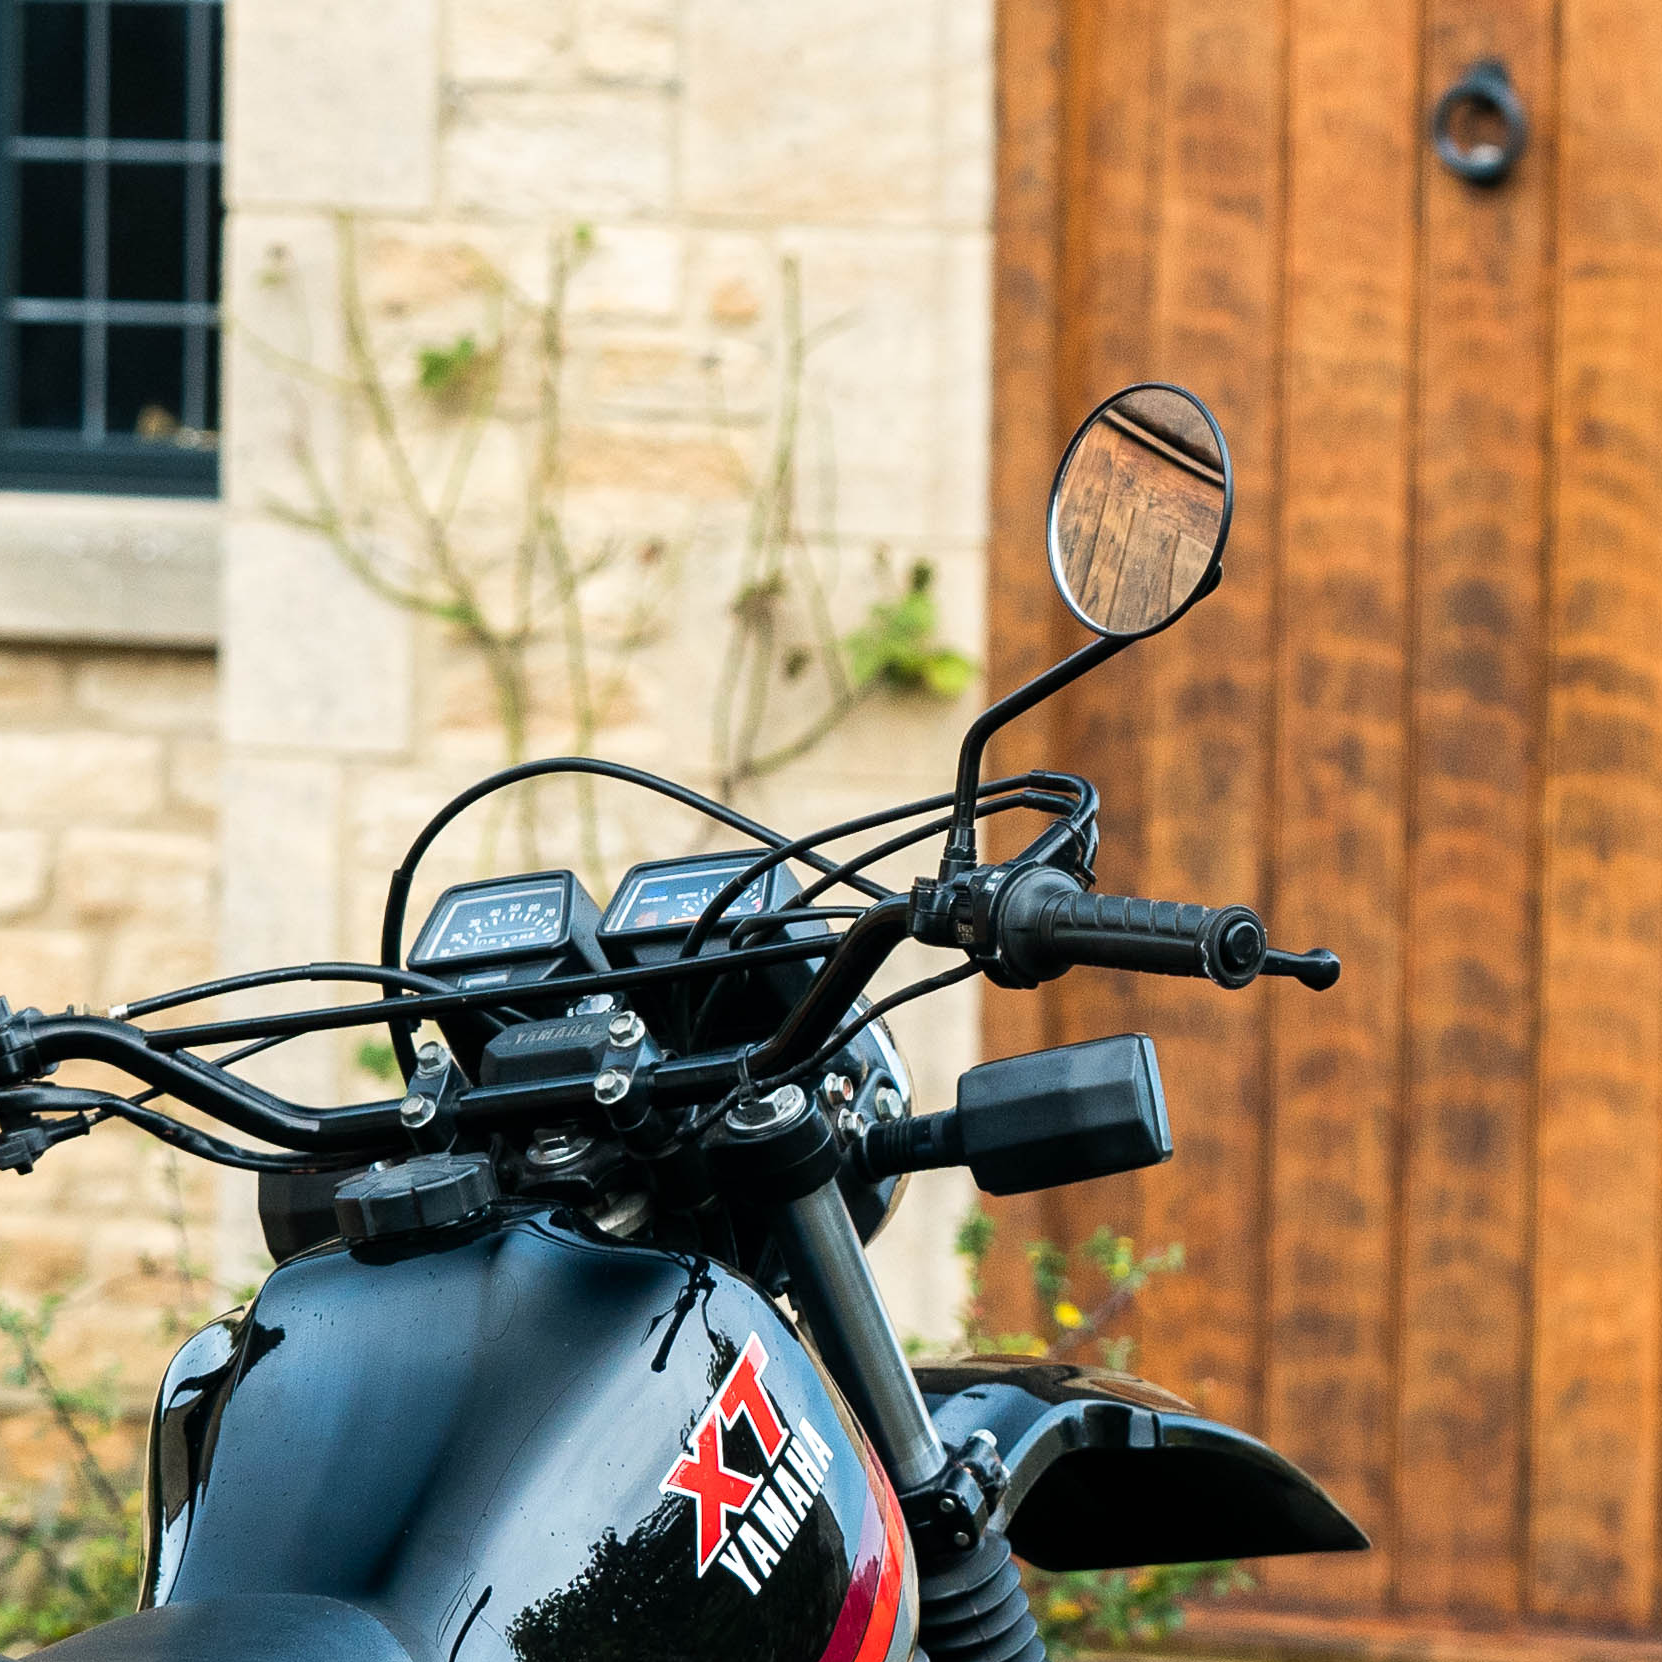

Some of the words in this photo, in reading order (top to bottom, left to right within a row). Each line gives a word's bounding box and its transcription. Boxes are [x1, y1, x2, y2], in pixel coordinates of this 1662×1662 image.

[489, 908, 502, 918] 40
[508, 903, 522, 913] 50
[528, 903, 542, 913] 60
[544, 907, 557, 918] 70
[515, 1022, 594, 1045] YAMAHA
[657, 1330, 791, 1578] XT
[717, 1416, 834, 1596] YAMAHA
